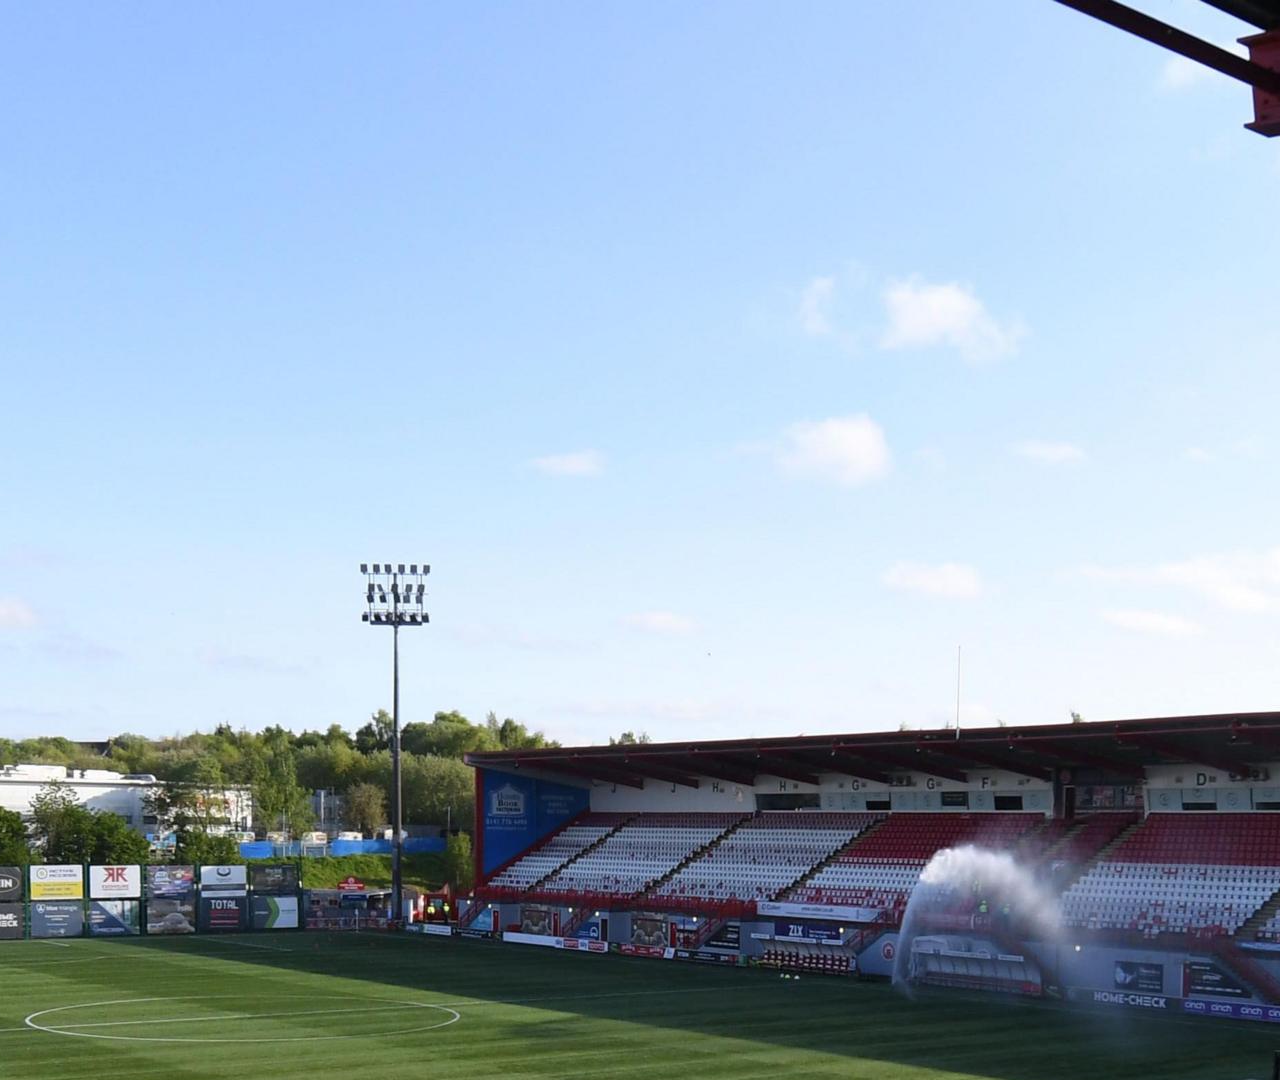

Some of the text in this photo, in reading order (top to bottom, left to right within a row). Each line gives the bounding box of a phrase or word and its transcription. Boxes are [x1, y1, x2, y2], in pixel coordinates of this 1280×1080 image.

[852, 780, 859, 790] G
[927, 779, 935, 790] G
[982, 778, 989, 788] F
[1196, 773, 1207, 786] D
[712, 782, 719, 793] H
[779, 781, 786, 791] H
[210, 900, 239, 909] TOTAL
[1094, 991, 1166, 1009] HOME-CHECK
[1185, 1001, 1205, 1010] cinch
[1211, 1003, 1232, 1013] cinch
[1240, 1006, 1263, 1016] cinch
